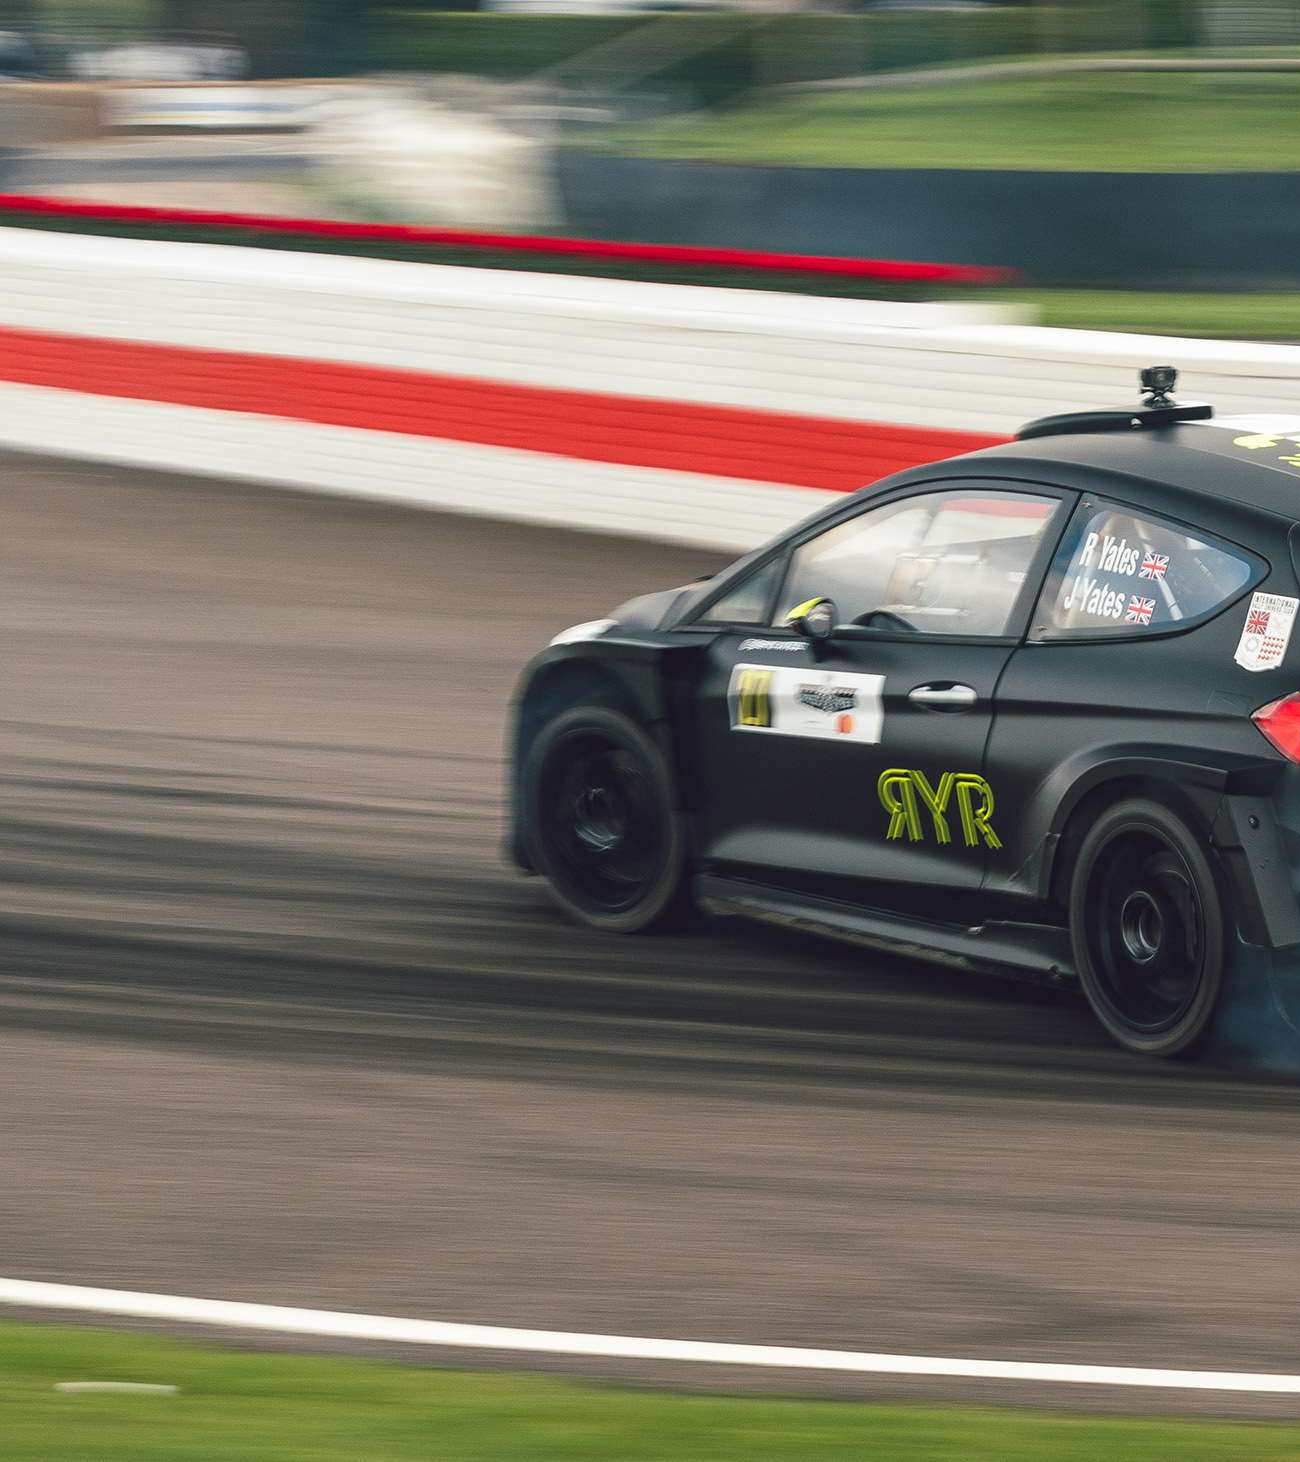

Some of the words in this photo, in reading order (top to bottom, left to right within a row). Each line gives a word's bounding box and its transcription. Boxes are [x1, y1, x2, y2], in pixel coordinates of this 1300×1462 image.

[1079, 532, 1099, 567] R
[1097, 535, 1140, 577] Yates
[1063, 575, 1081, 609] J
[1079, 577, 1126, 619] Yates
